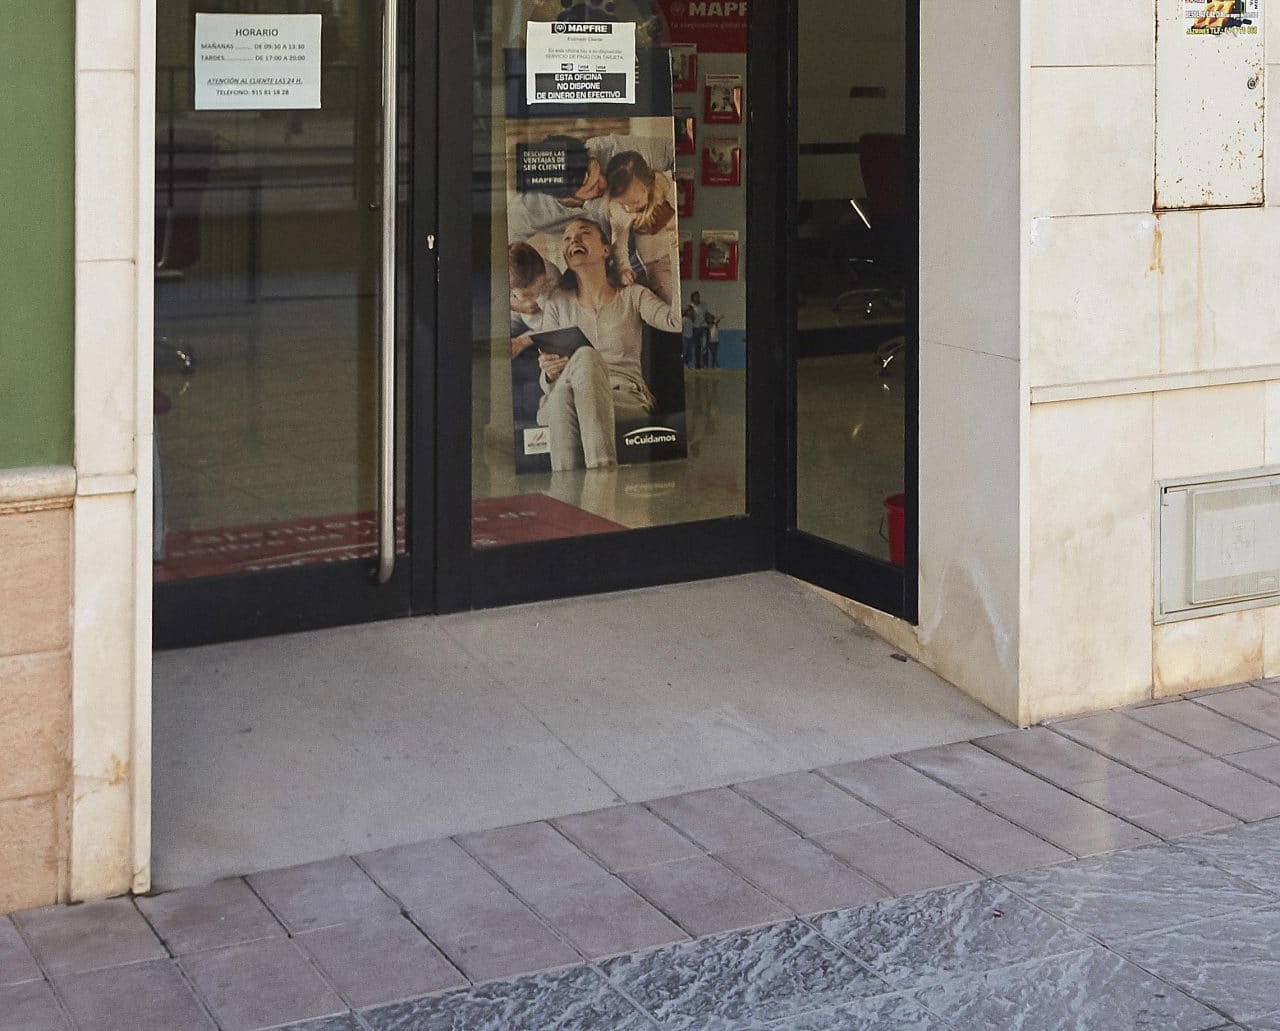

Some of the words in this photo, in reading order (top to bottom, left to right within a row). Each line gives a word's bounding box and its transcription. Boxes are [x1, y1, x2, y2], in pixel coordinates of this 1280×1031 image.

[235, 28, 279, 37] HORARIO
[567, 24, 608, 33] MAPFRE
[556, 82, 569, 90] NO
[569, 82, 601, 90] DISPONE
[536, 91, 547, 99] DE
[547, 91, 575, 99] DINERO
[576, 91, 587, 99] EN
[587, 90, 621, 99] EFECTIVO
[537, 163, 566, 171] CLIENTE
[625, 433, 677, 446] teCuidamos
